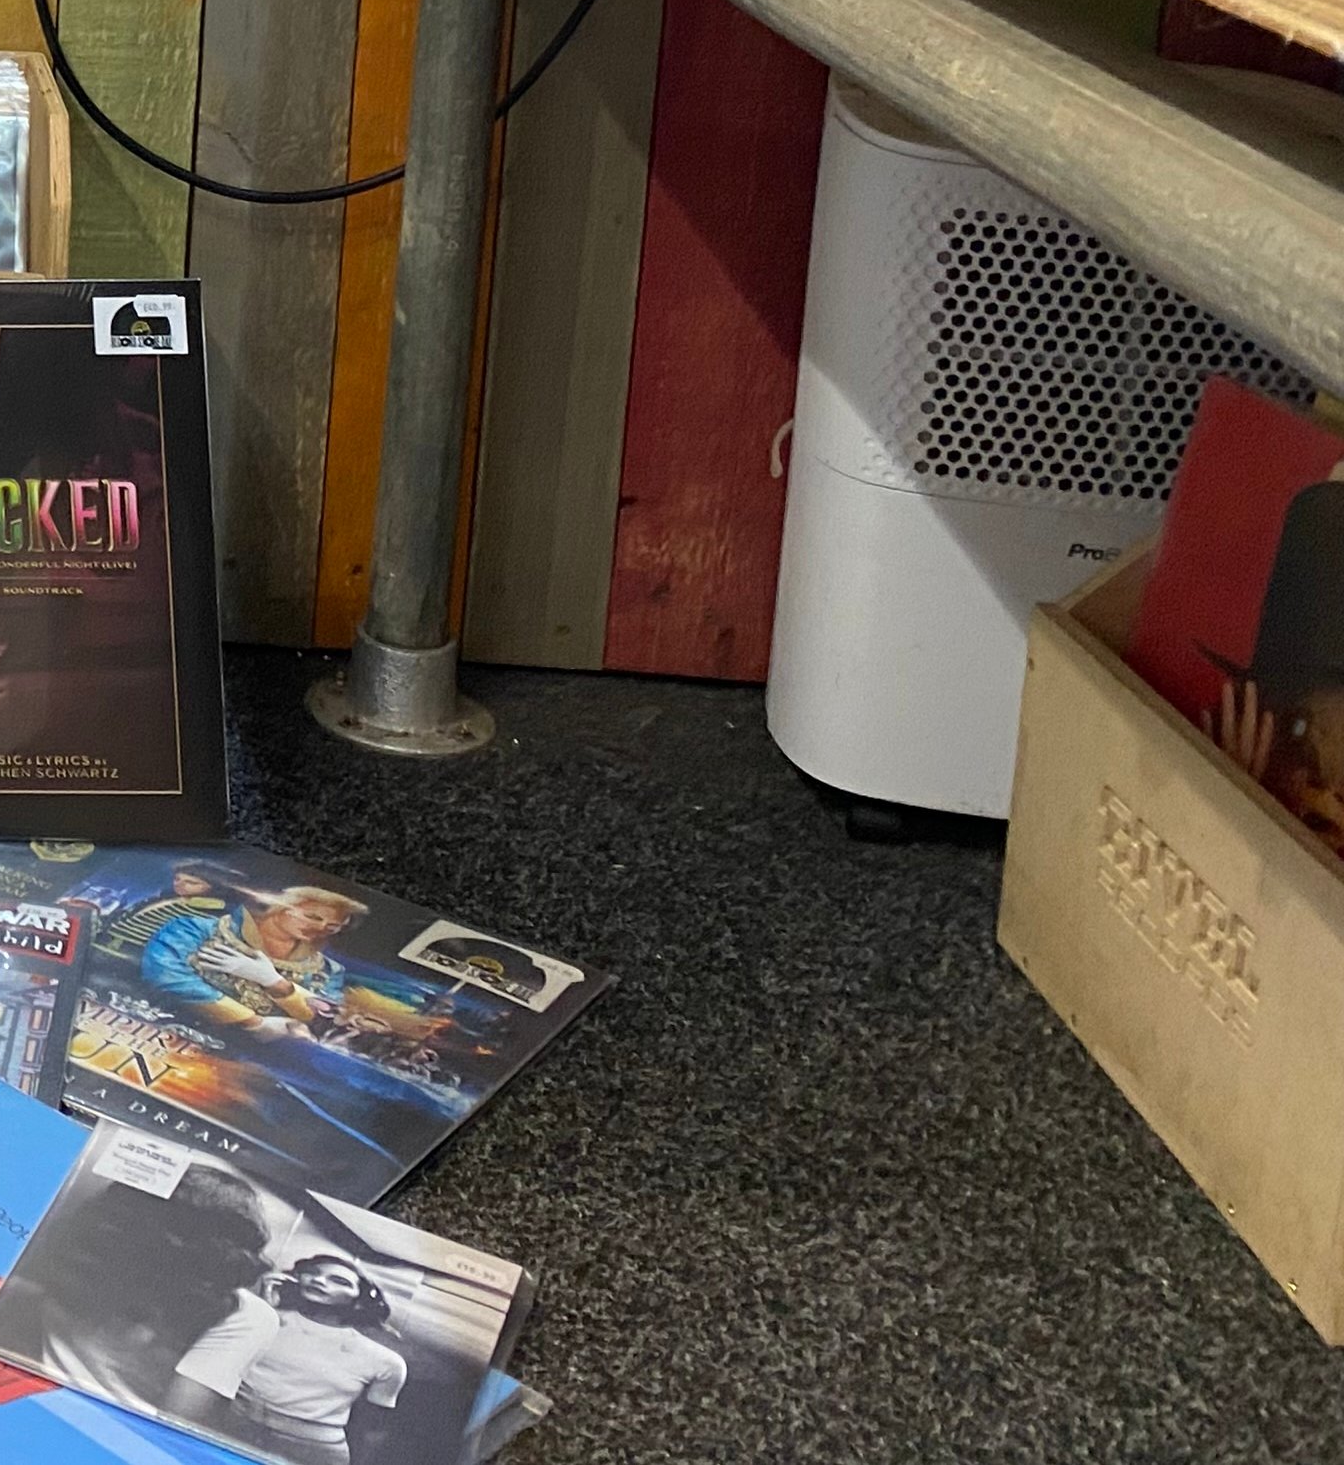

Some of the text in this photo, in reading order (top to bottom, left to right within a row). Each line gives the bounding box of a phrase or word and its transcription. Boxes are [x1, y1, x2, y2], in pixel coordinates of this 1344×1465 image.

[2, 587, 85, 595] SOUNDTRACK
[35, 755, 91, 766] LYRICS
[35, 767, 120, 779] SCHWARTZ
[78, 998, 205, 1057] MPIRE
[69, 1030, 181, 1088] UN
[128, 1100, 241, 1153] DREAM
